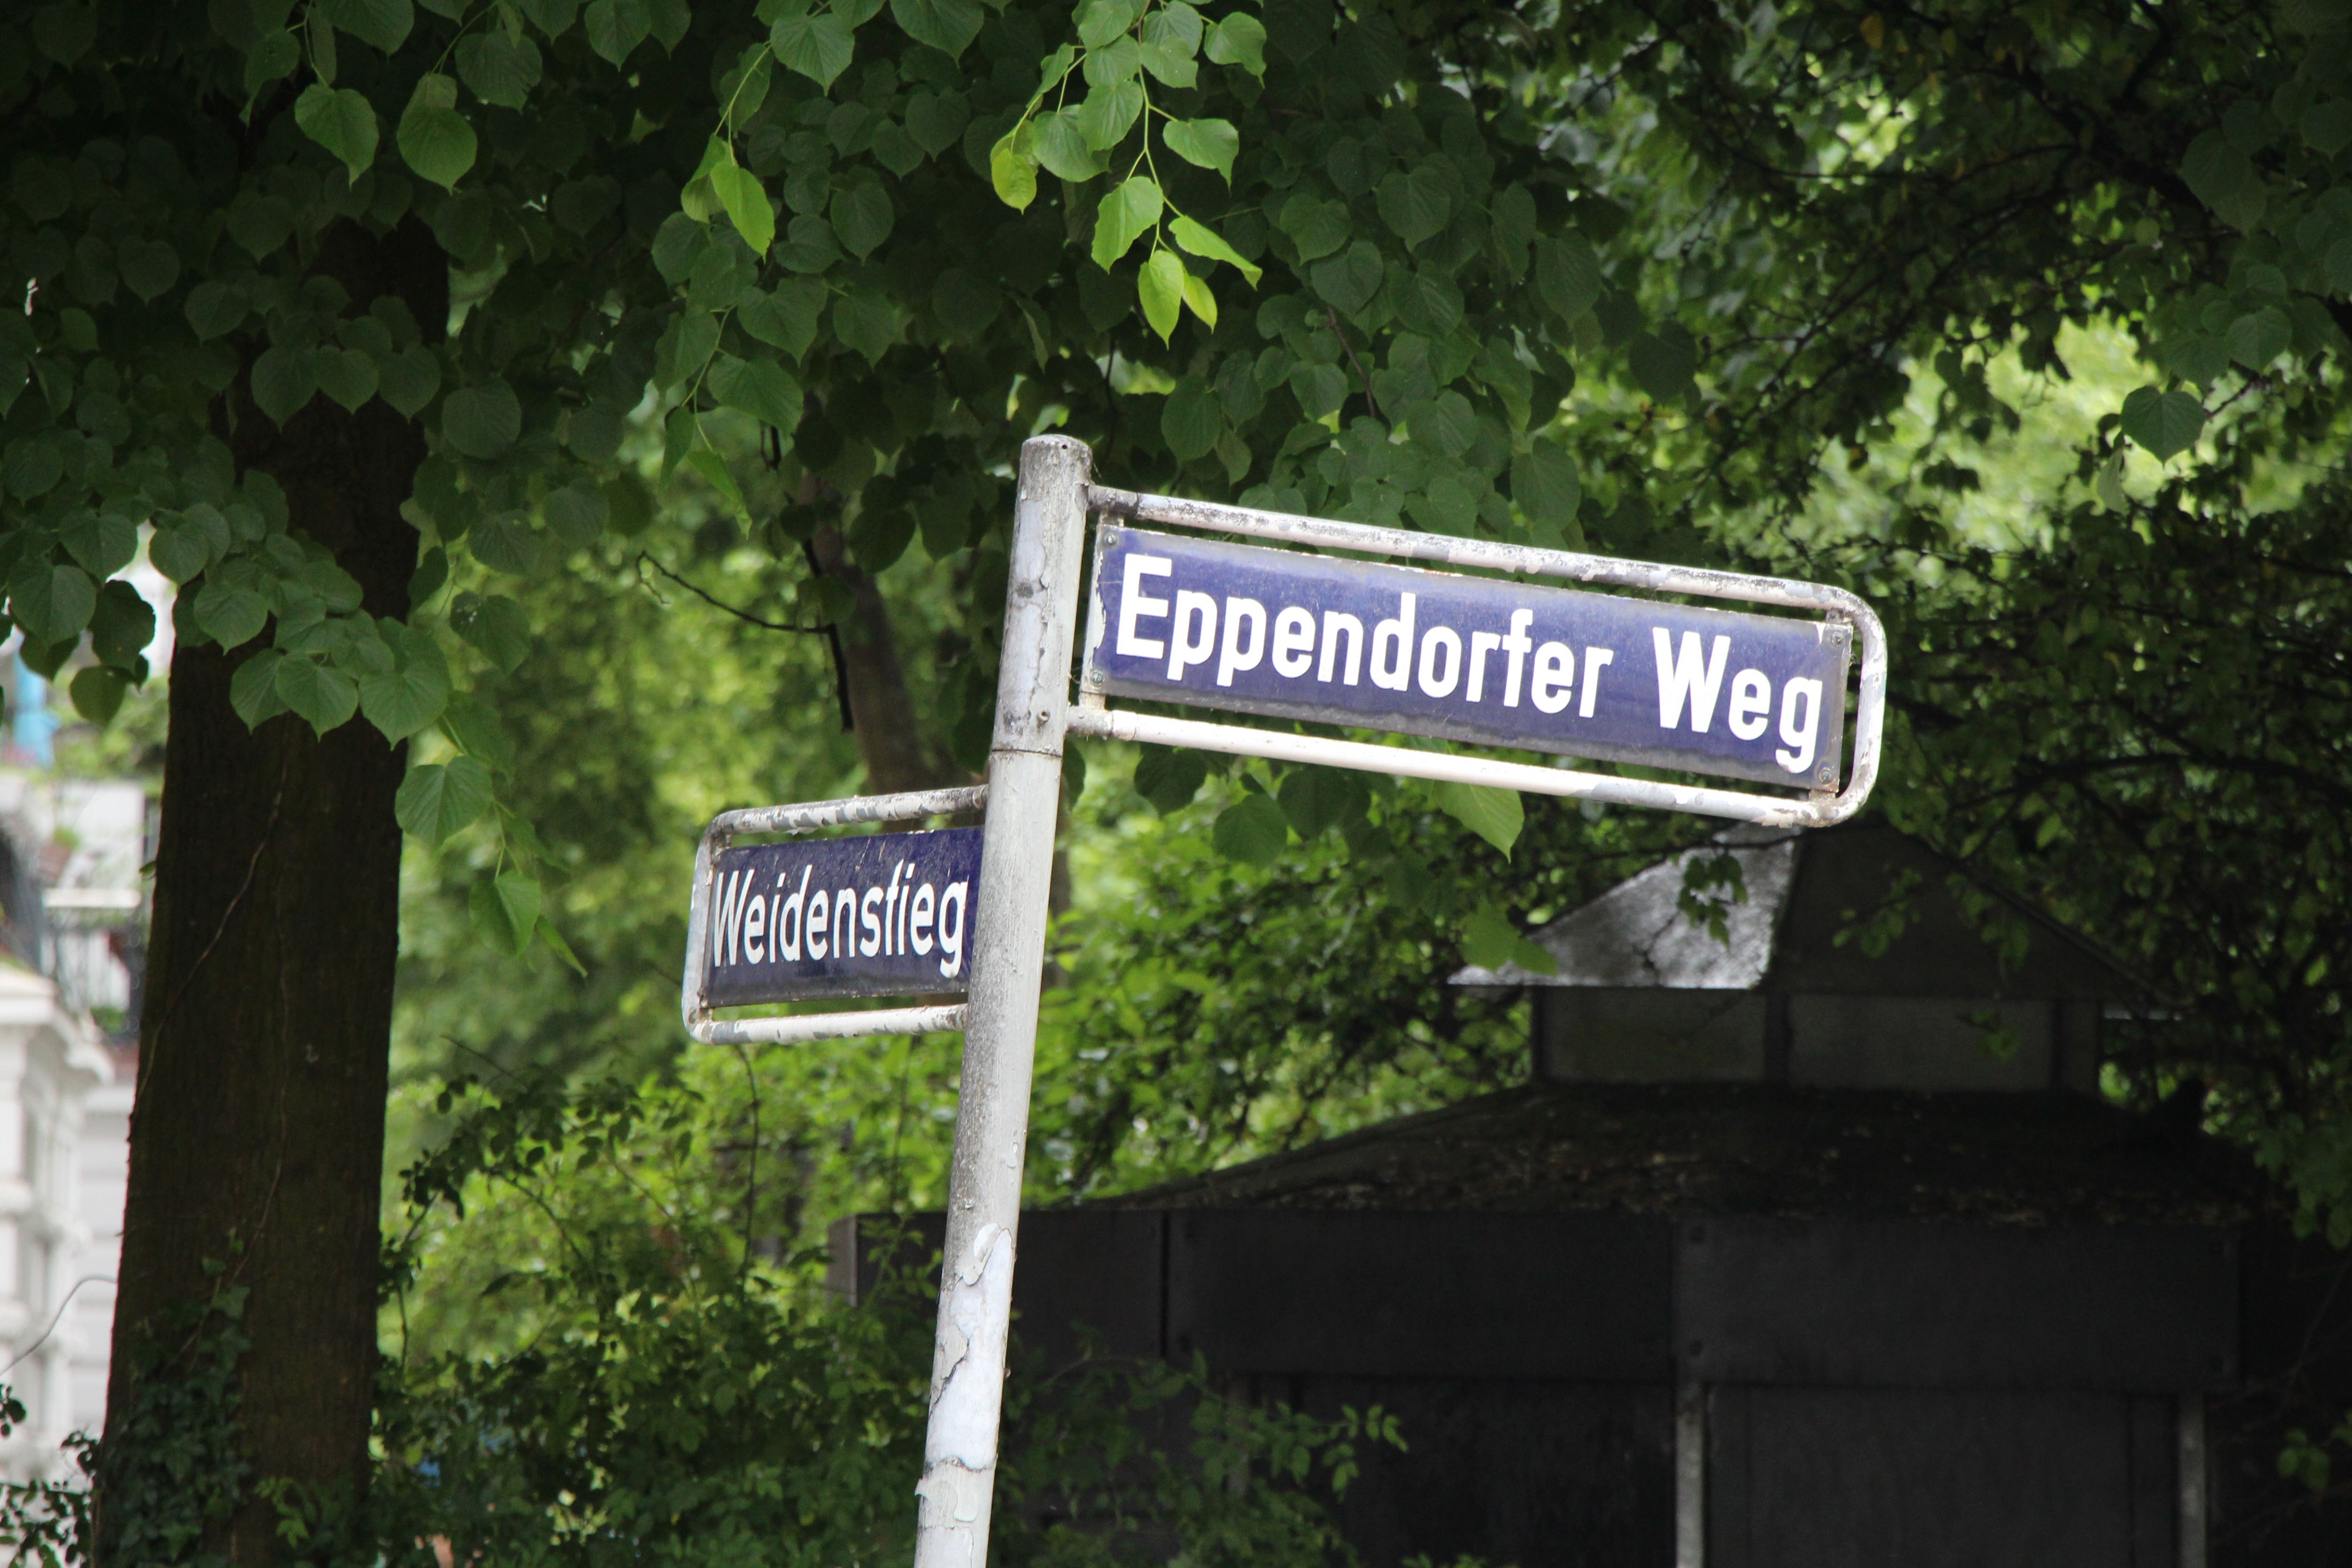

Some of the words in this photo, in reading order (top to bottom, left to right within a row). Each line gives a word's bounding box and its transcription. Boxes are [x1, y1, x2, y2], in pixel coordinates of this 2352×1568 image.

[1115, 553, 1614, 719] Eppendorfer
[1652, 627, 1823, 774] Weg
[714, 859, 969, 979] Weidenstieg
